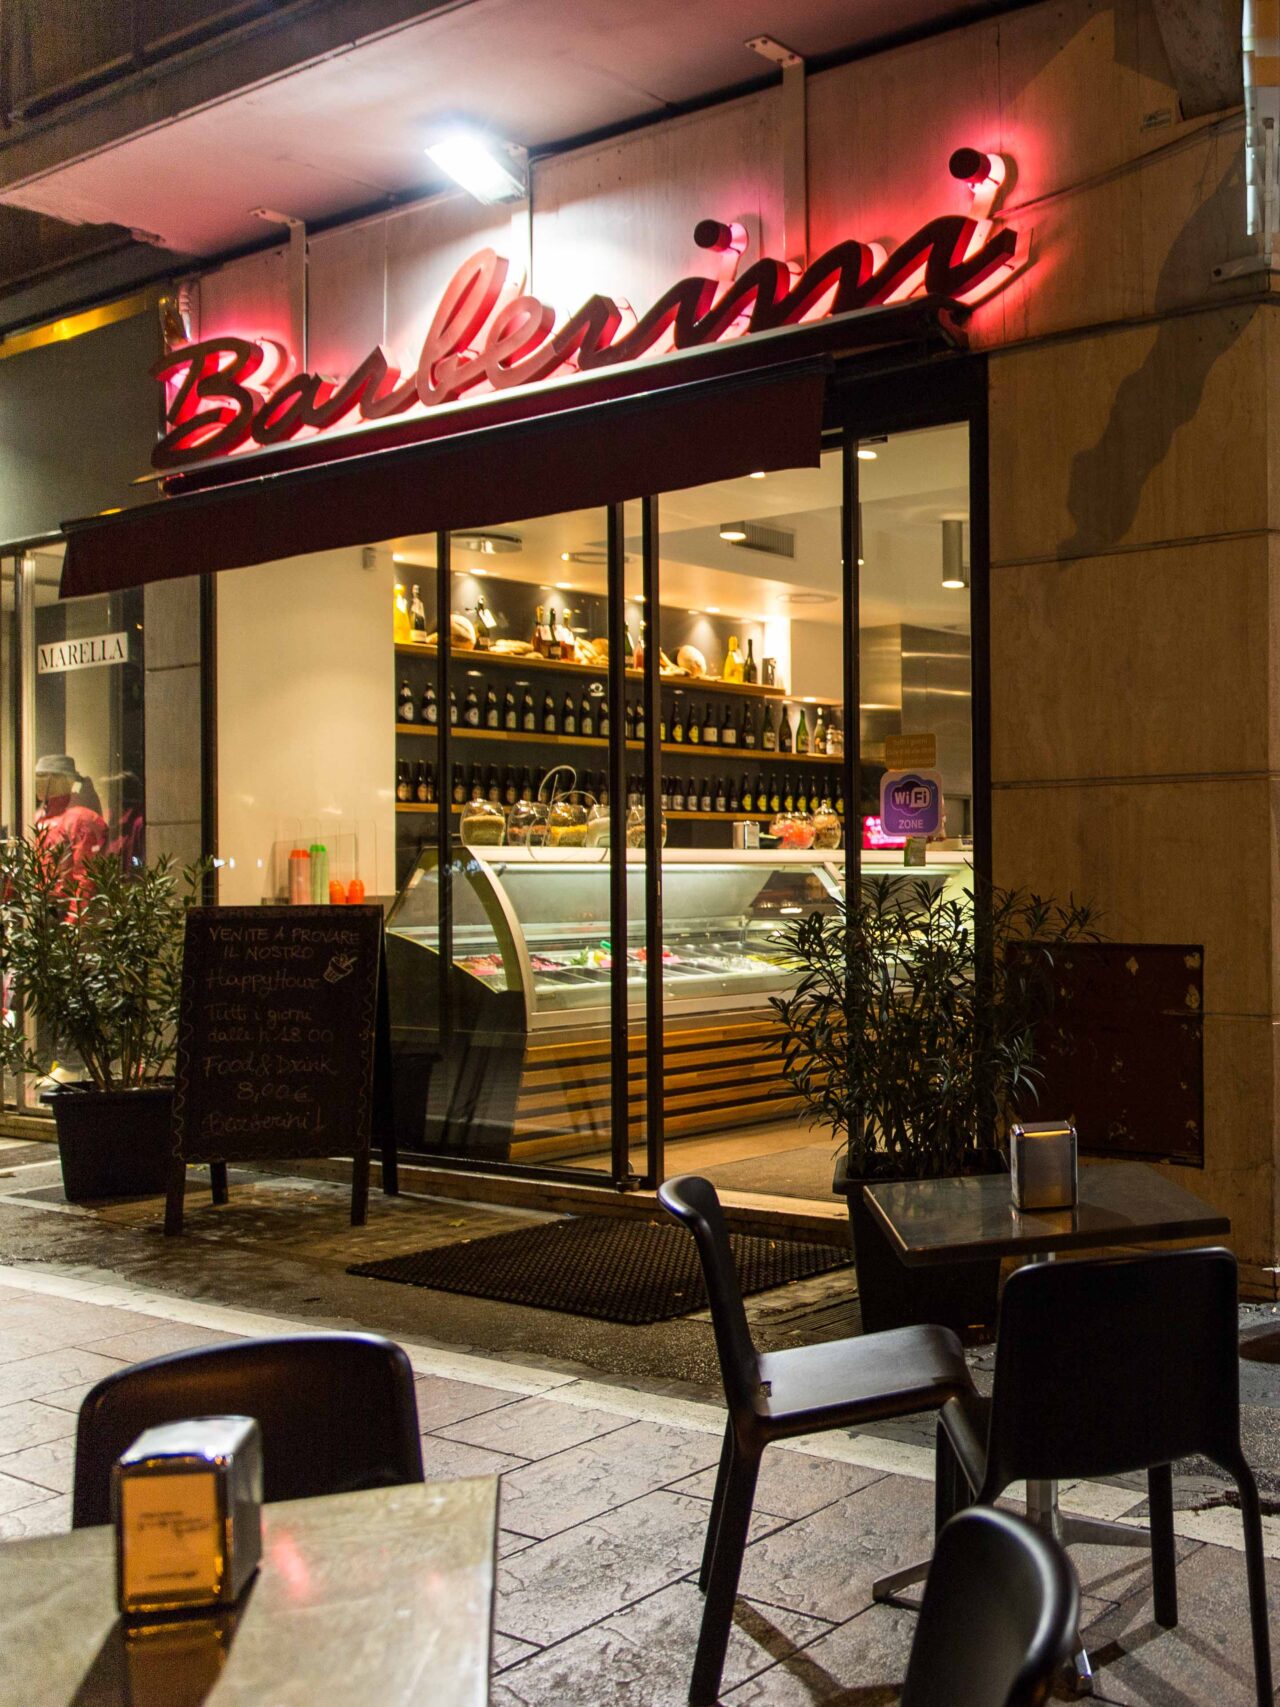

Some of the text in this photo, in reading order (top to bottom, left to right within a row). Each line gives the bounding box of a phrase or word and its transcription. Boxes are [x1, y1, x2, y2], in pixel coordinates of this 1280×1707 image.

[151, 147, 1022, 470] Barberini
[41, 638, 124, 671] MARELLA
[898, 818, 924, 829] ZONE
[208, 925, 269, 942] VENITE
[291, 927, 360, 945] PROVARE
[223, 944, 315, 961] IL NOSTRO
